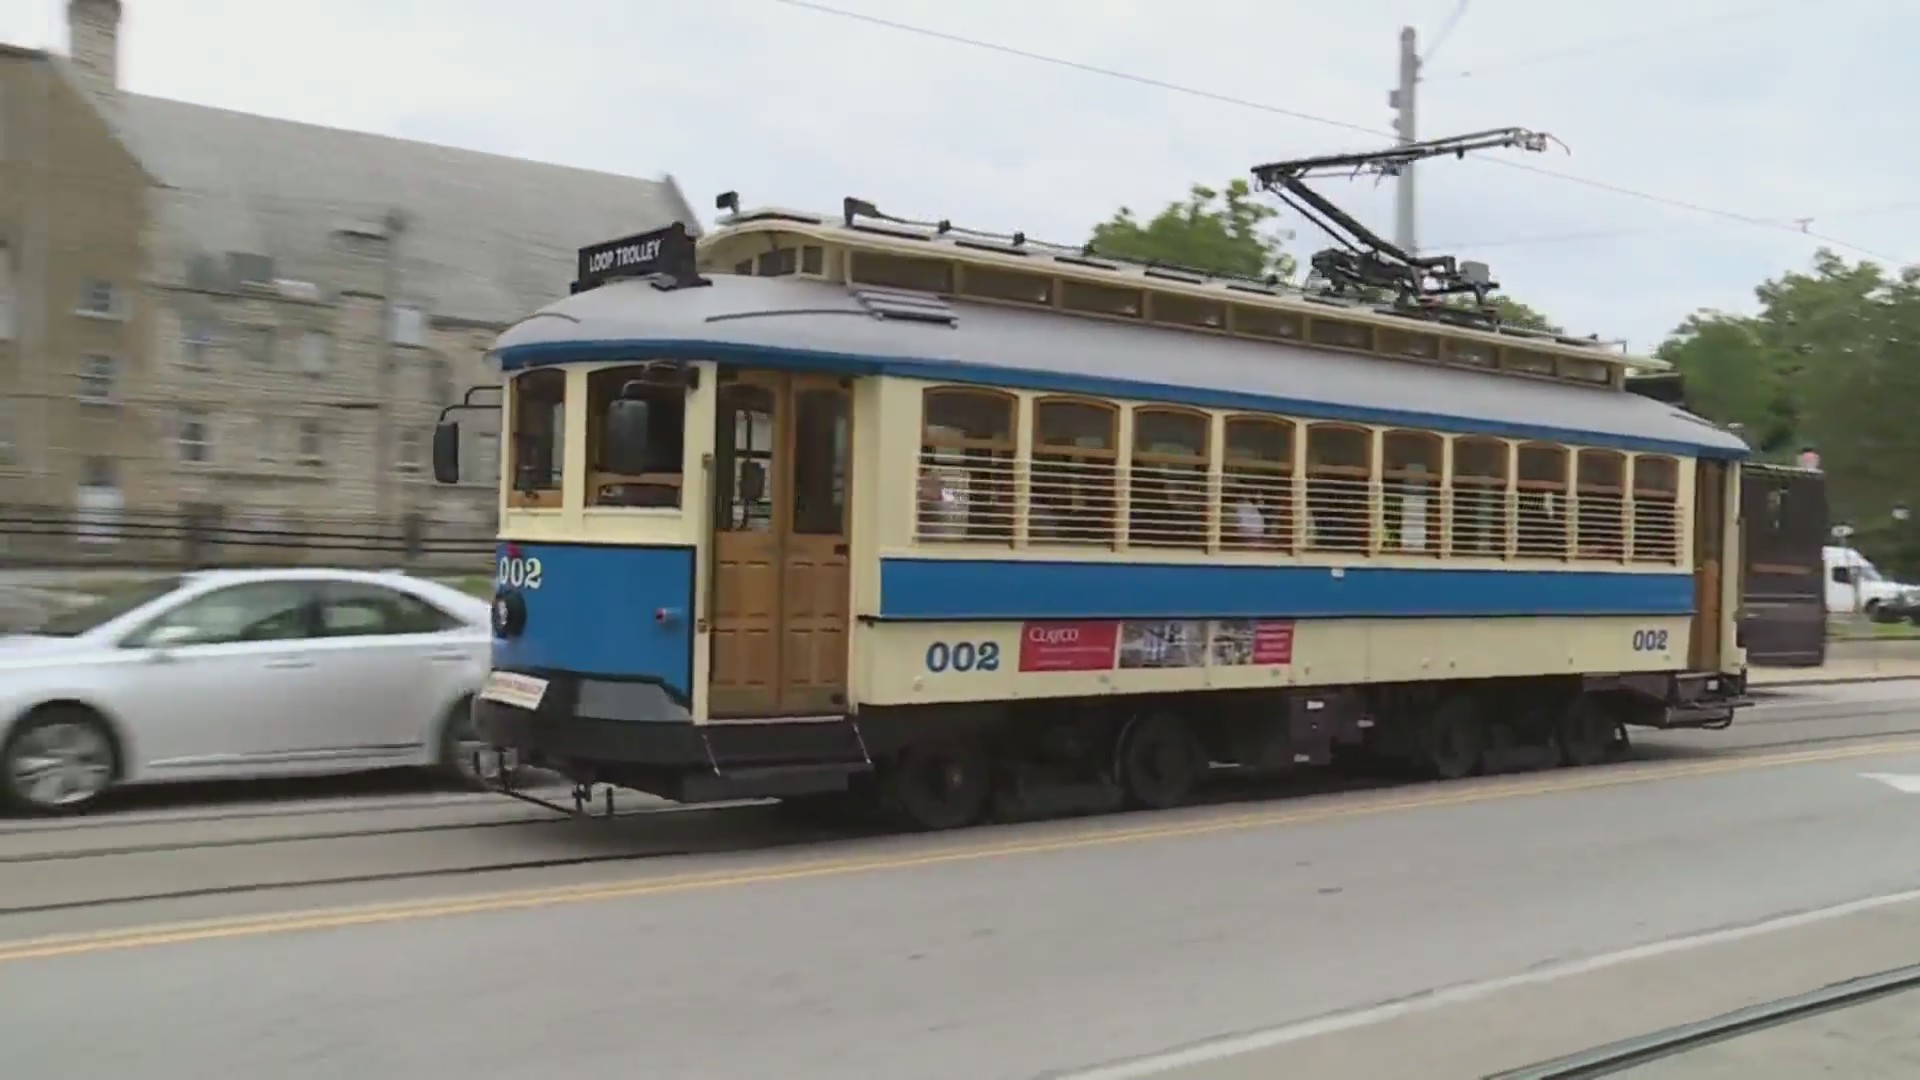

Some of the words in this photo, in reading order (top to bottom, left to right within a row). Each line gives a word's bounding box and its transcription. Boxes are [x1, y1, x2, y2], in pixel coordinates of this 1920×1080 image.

[589, 250, 615, 273] LOOP
[615, 239, 662, 267] TROLLEY
[499, 556, 542, 589] 002
[1632, 629, 1669, 651] 002
[925, 641, 1000, 673] 002
